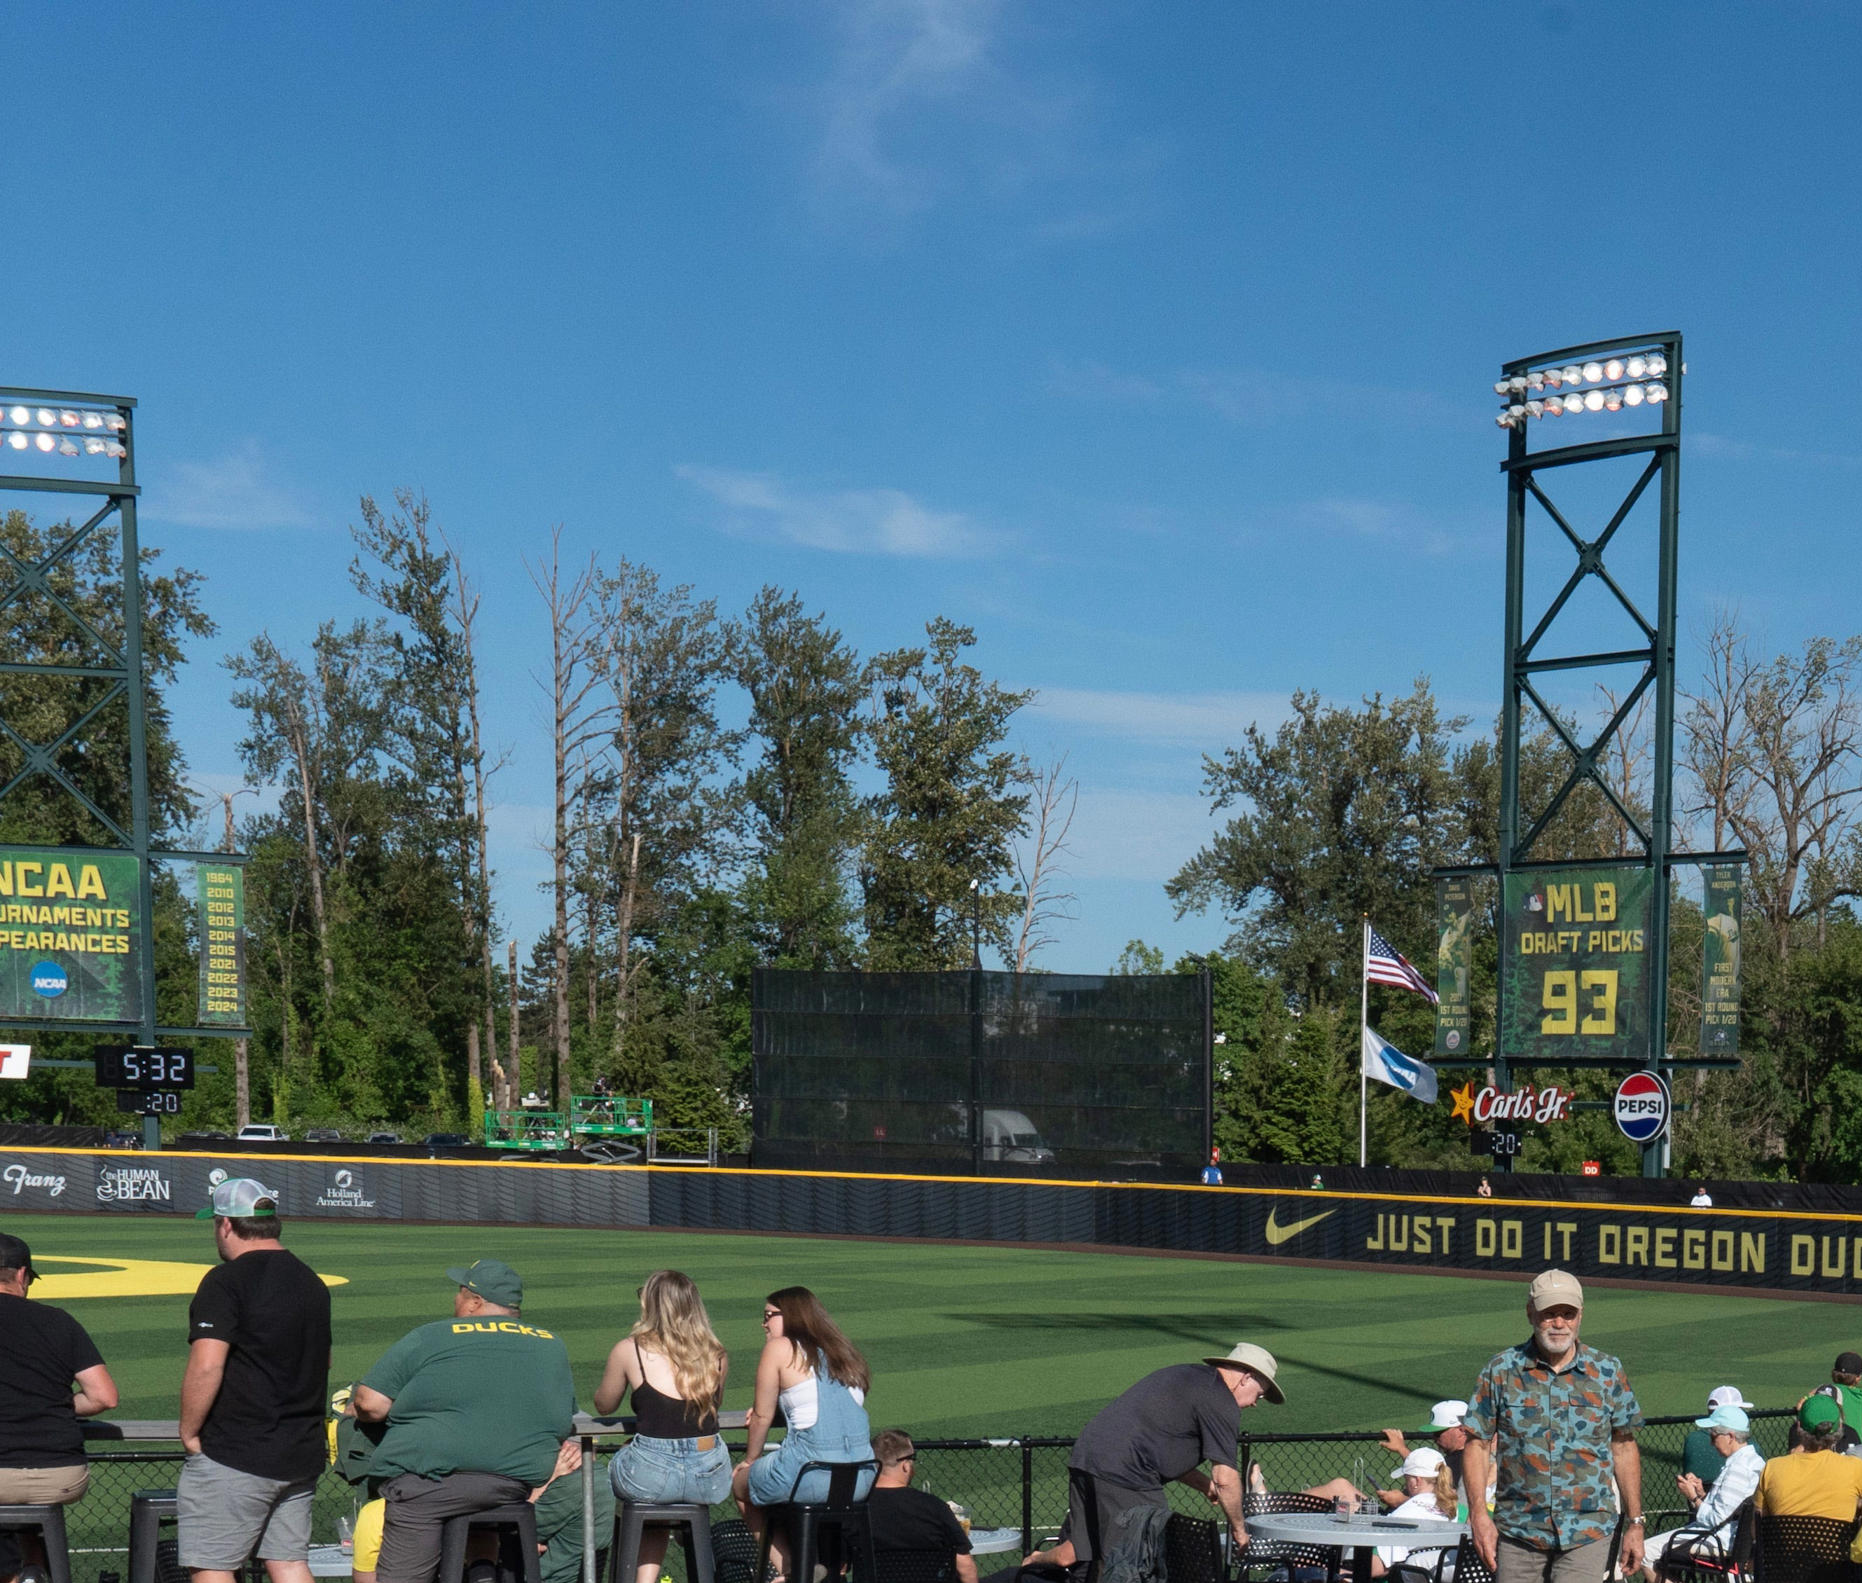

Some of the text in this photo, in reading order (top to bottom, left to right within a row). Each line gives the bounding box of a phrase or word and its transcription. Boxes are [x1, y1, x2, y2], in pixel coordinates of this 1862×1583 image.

[206, 872, 233, 883] 1964
[207, 887, 234, 899] 2010
[207, 901, 235, 913] 2012
[1546, 882, 1617, 923] MLB
[208, 915, 235, 927] 2013
[208, 930, 235, 941] 2014
[1521, 929, 1644, 955] DRAFT PICKS
[208, 944, 236, 956] 2015
[209, 958, 236, 969] 2021
[33, 978, 67, 989] NCAA
[207, 973, 238, 984] 2022
[207, 986, 238, 998] 2023
[207, 1001, 238, 1012] 2024
[1541, 969, 1619, 1035] 93
[123, 1053, 186, 1082] 5:32
[1474, 1085, 1566, 1124] Carl's Jr.
[1618, 1099, 1662, 1114] PEPSI
[117, 1168, 160, 1181] HUMAN
[1584, 1165, 1598, 1175] DD
[3, 1164, 68, 1197] Franz
[117, 1180, 171, 1200] BEAN
[327, 1187, 362, 1199] Holland
[316, 1196, 375, 1208] America Line
[1367, 1213, 1455, 1255] JUST
[1476, 1218, 1523, 1259] DO
[1544, 1221, 1578, 1262] IT
[1599, 1224, 1766, 1274] OREGON
[451, 1321, 555, 1340] DUCKS
